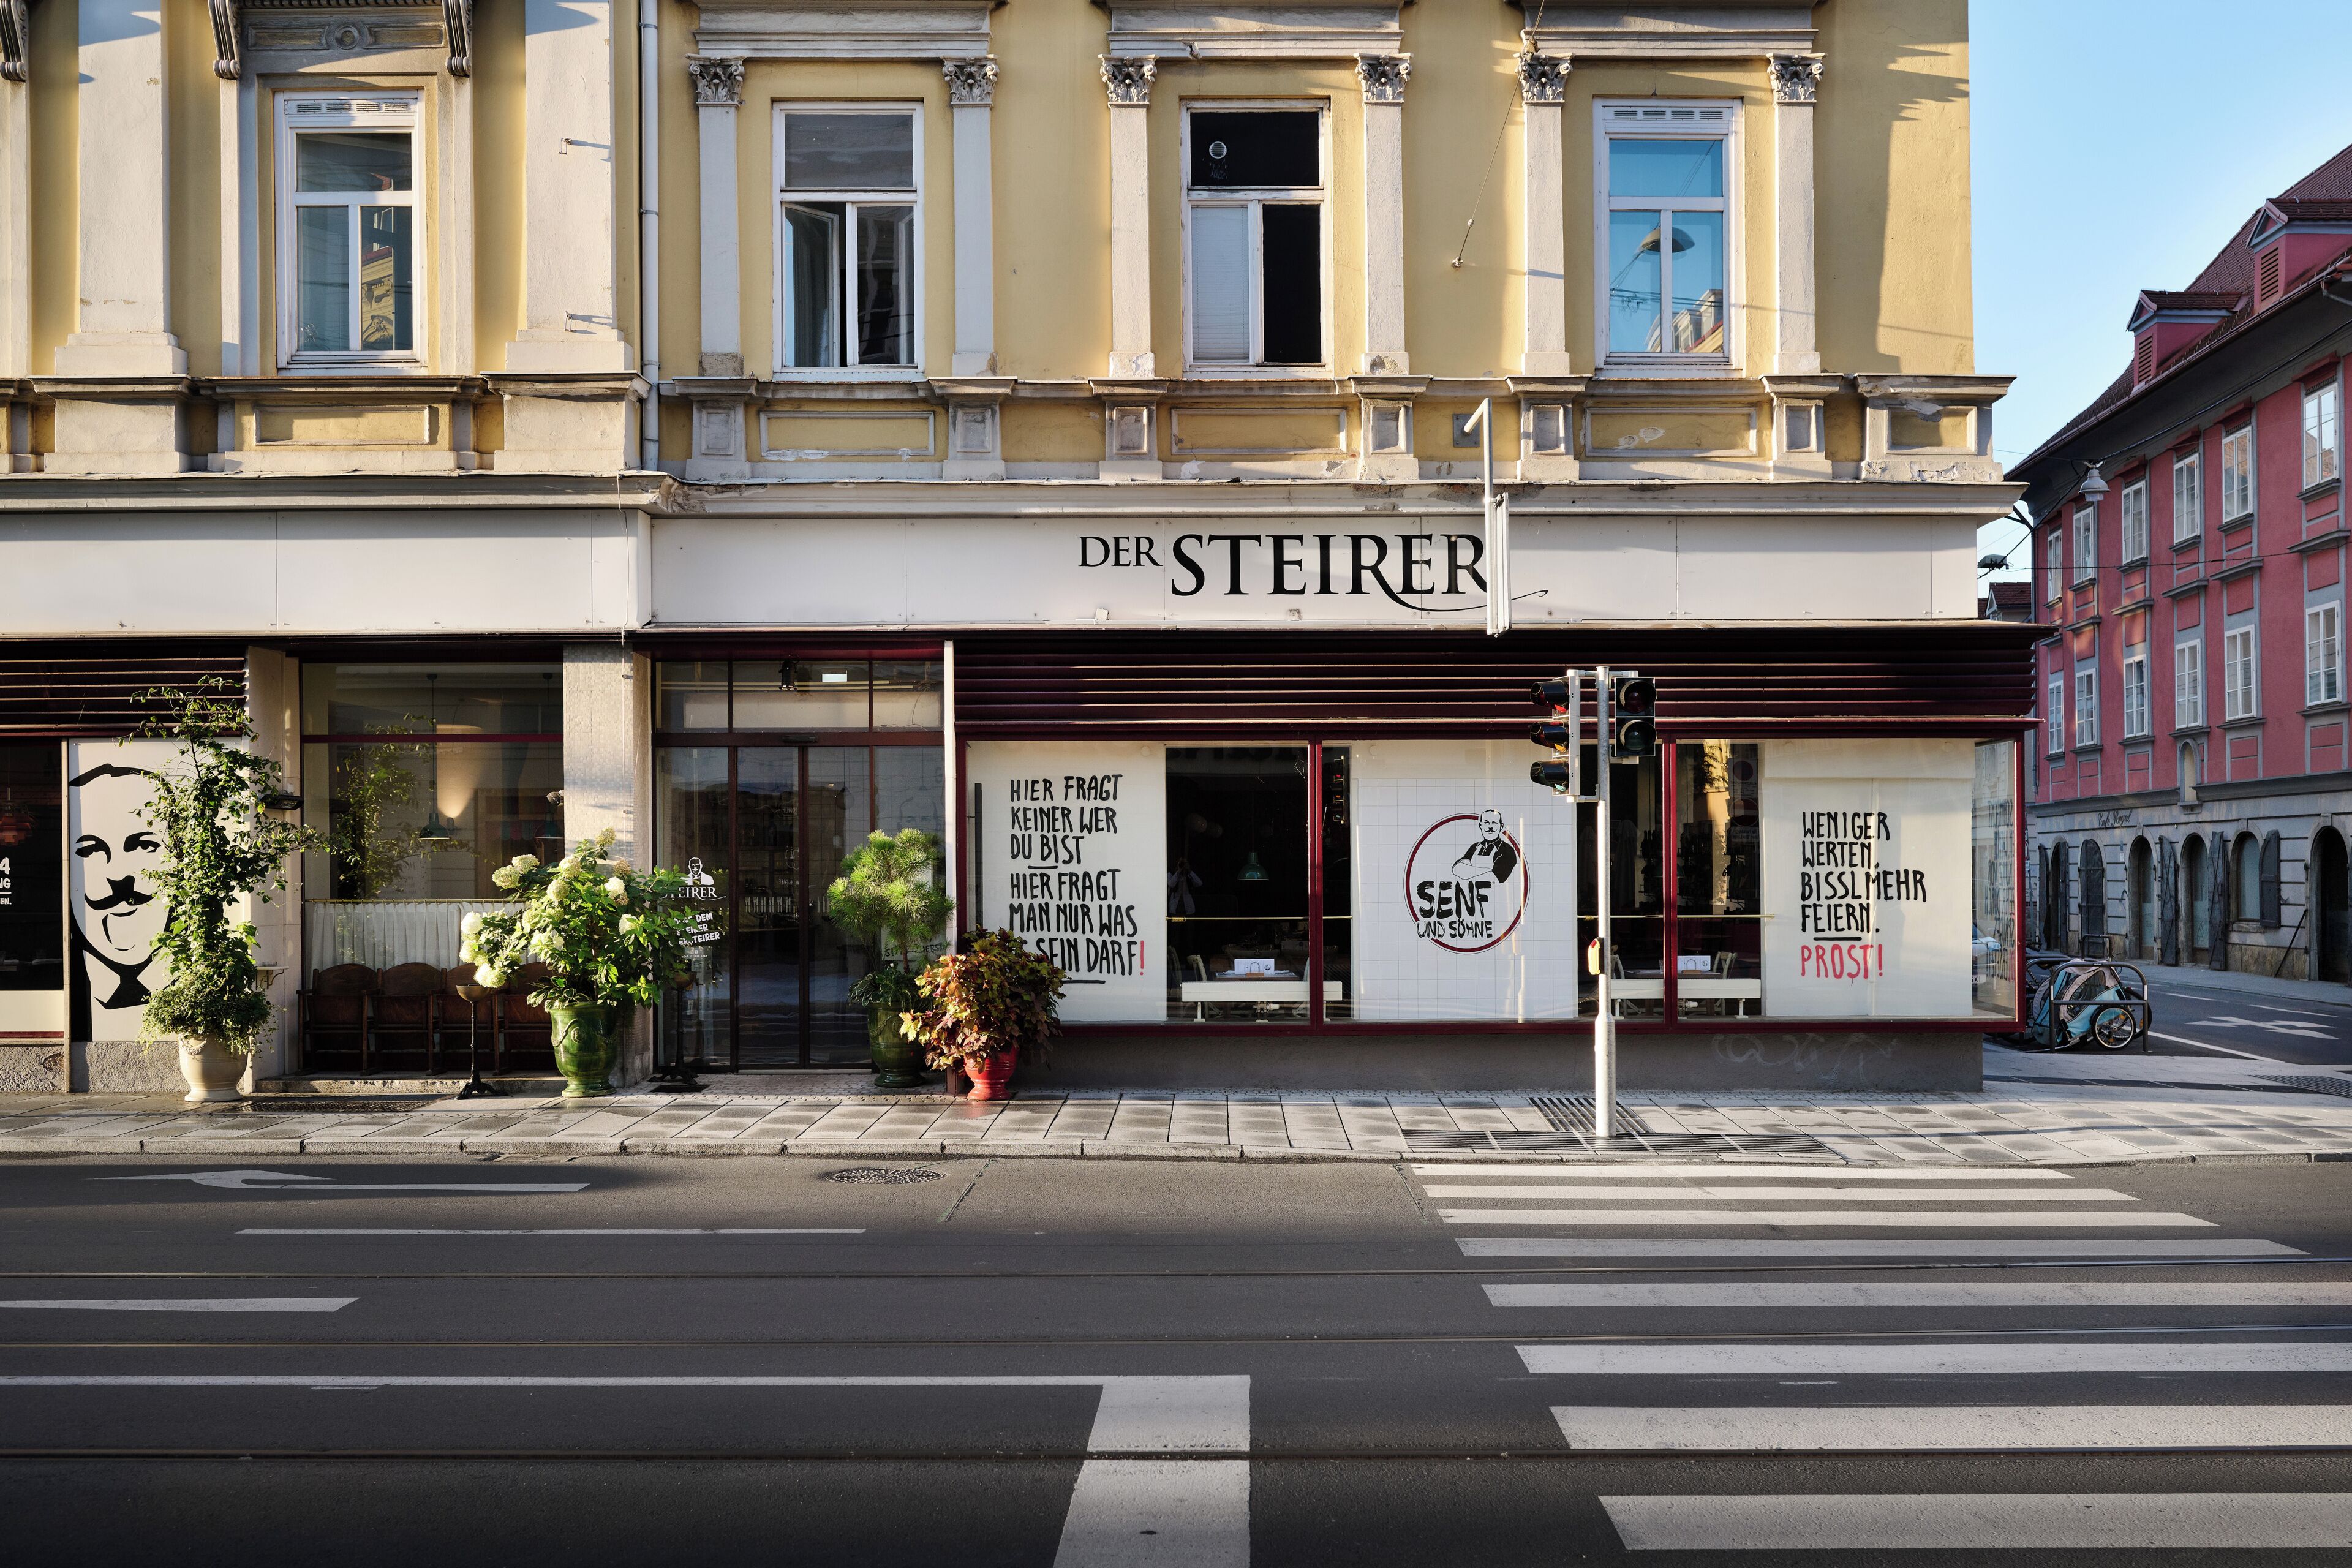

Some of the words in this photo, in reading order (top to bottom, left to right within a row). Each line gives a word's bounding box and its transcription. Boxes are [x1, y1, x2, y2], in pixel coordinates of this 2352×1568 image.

[1077, 536, 1164, 567] DER
[1171, 533, 1550, 612] STEIRER
[1011, 778, 1054, 802] HIER
[1064, 774, 1123, 802] FRAGT
[1011, 807, 1073, 833] KEINER
[1079, 807, 1117, 834] WER
[1803, 812, 1890, 840] WENIGER
[1011, 834, 1032, 859] DU
[1041, 834, 1085, 865] BIST
[1011, 873, 1053, 900] HIER
[1058, 869, 1121, 901] FRAGT
[1416, 880, 1491, 918] SENF
[696, 912, 713, 922] DEM
[1009, 902, 1050, 933] MAN
[1056, 903, 1093, 934] NUR
[1099, 903, 1137, 937] WAS
[1417, 921, 1445, 938] UND
[1449, 918, 1493, 938] SÖHNE
[1801, 903, 1880, 933] FEIERN.
[1087, 938, 1144, 976] DARF!
[1801, 944, 1883, 979] PROST!
